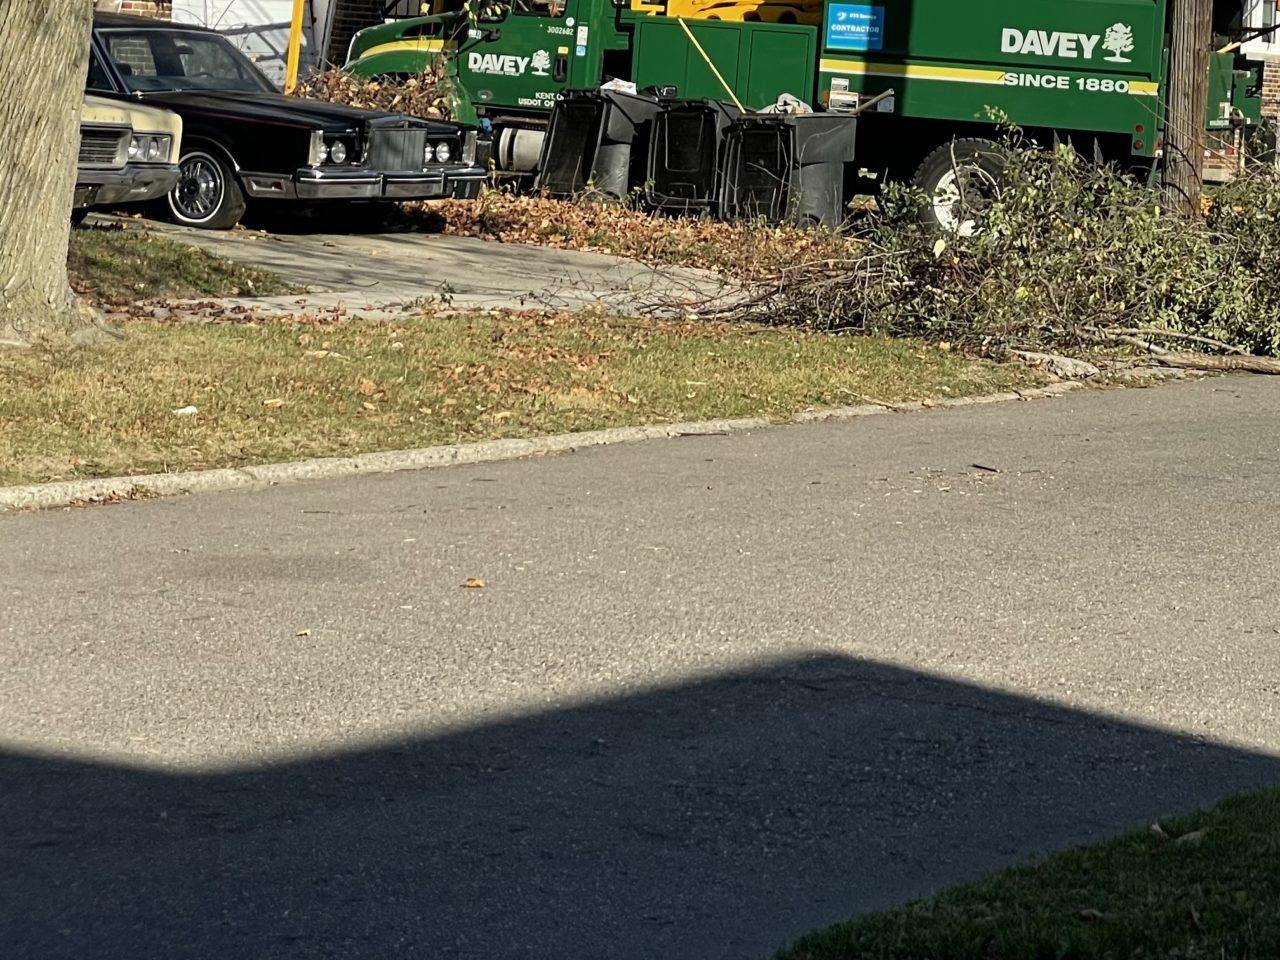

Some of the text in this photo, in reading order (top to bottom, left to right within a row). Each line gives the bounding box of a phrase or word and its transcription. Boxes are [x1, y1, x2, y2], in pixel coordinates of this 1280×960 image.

[831, 24, 880, 33] CONTRACTOR
[1000, 28, 1100, 59] DAVEY
[468, 52, 530, 74] DAVEY
[1004, 72, 1129, 93] SINCE 1880
[518, 97, 541, 107] USDOT
